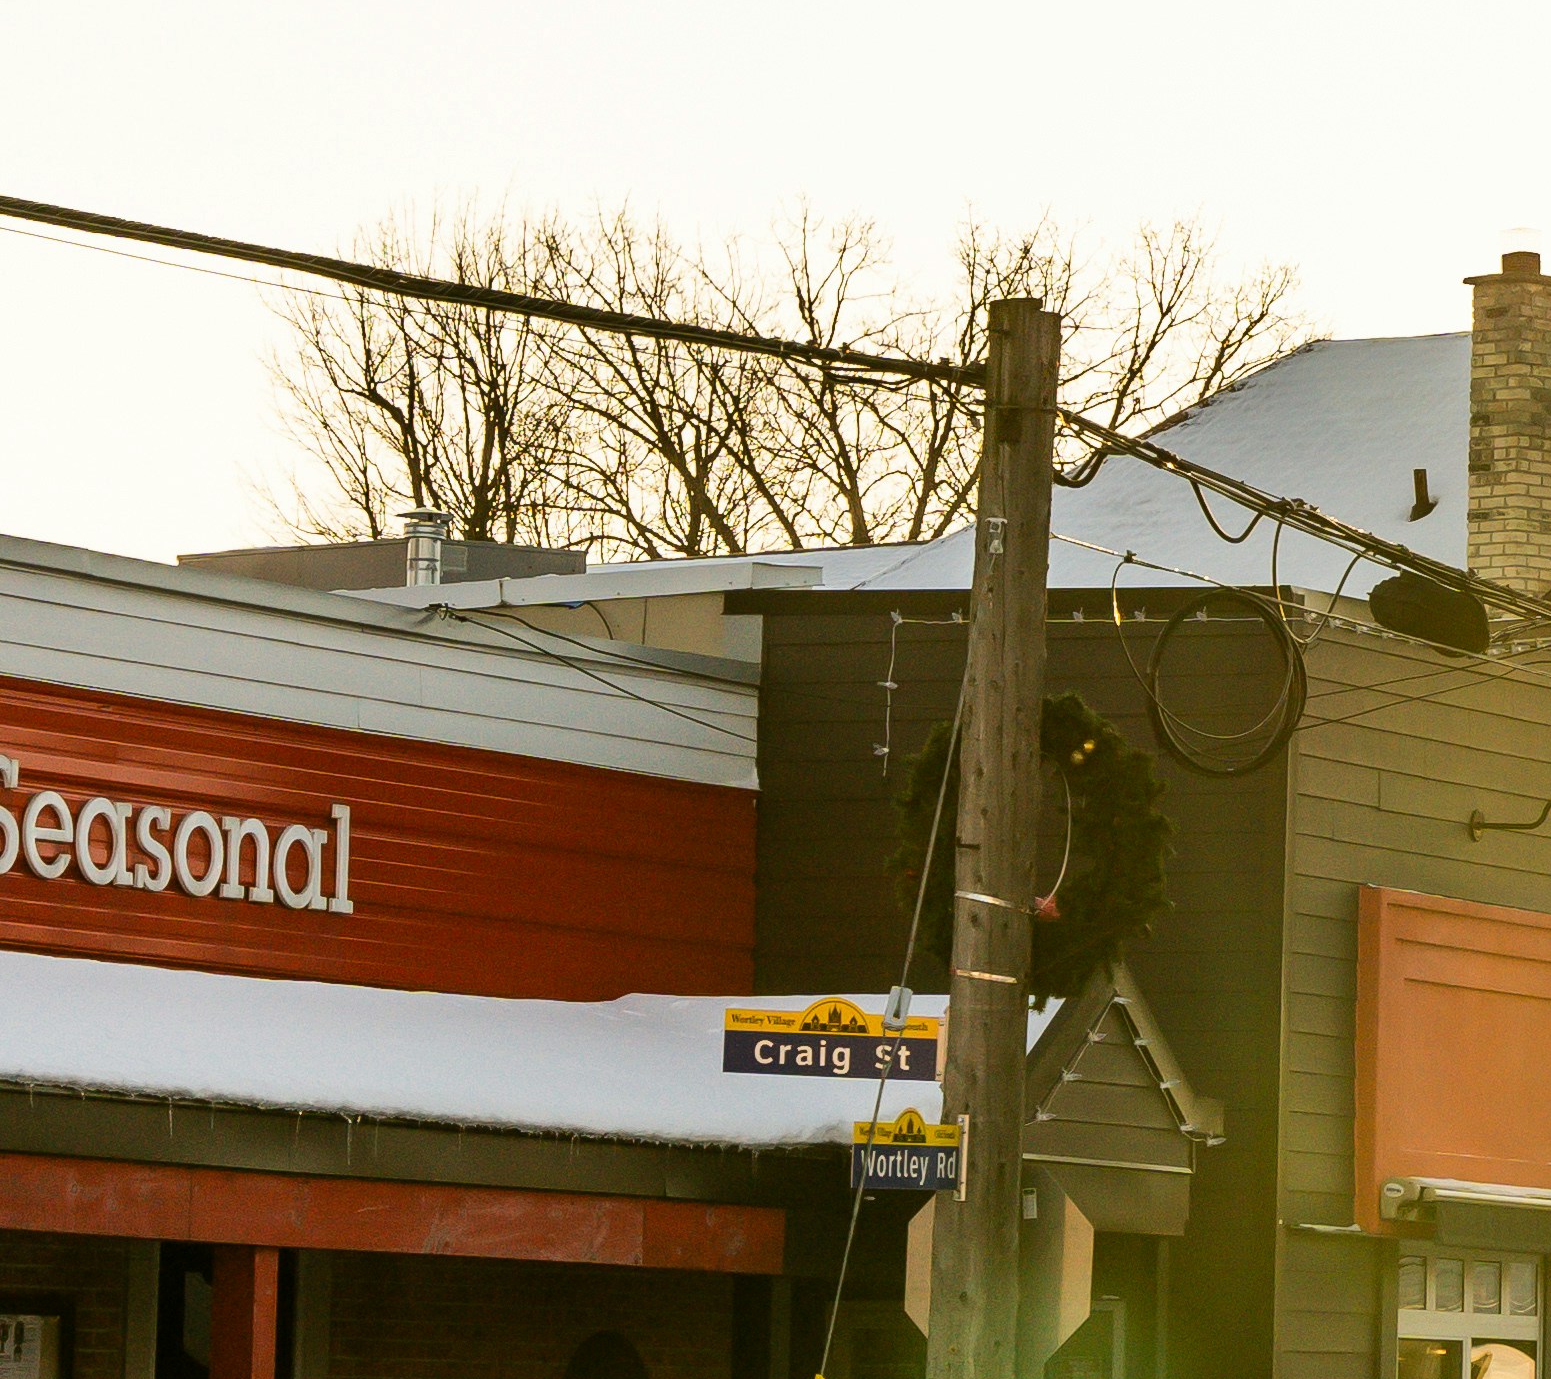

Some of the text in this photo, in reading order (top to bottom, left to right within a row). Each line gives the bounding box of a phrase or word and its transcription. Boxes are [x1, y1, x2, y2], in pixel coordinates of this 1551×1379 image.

[731, 1013, 765, 1025] Wortley
[766, 1015, 796, 1026] Village
[754, 1039, 911, 1075] Craig St
[861, 1149, 956, 1186] Wortley Rd
